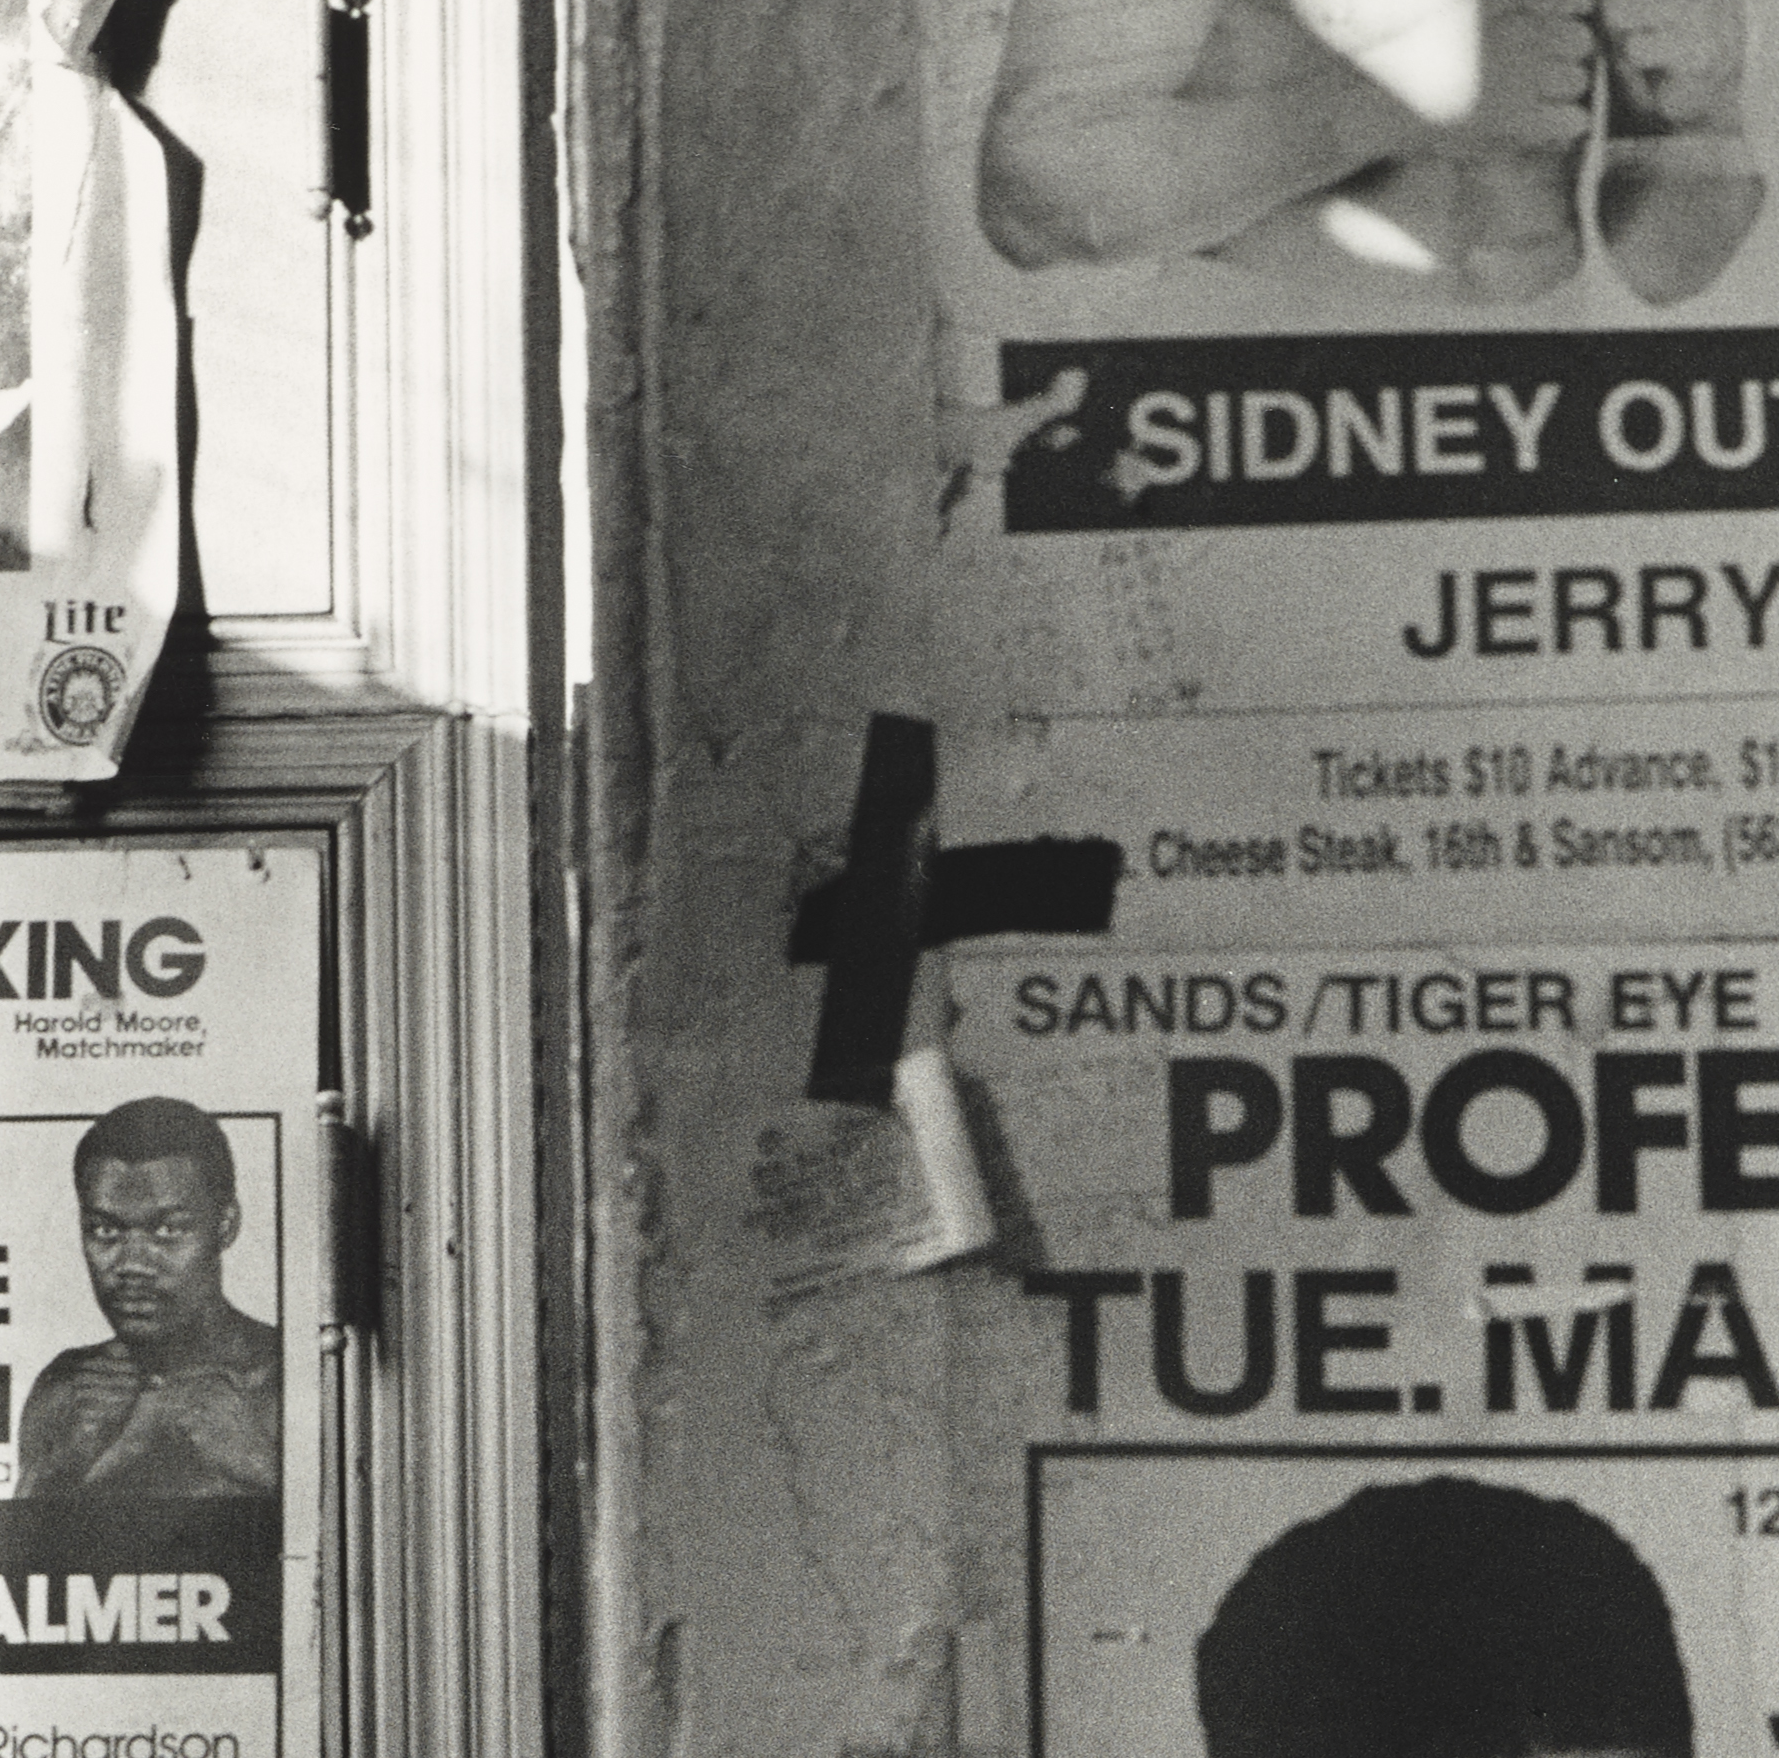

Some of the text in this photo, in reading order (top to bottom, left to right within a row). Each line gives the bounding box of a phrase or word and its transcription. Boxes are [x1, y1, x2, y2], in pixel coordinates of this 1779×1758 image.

[1127, 381, 1562, 487] SIDNEY
[41, 599, 128, 646] Lite
[1312, 743, 1452, 803] Tickets
[1543, 739, 1720, 795] Advance,
[1515, 820, 1541, 871] &
[13, 1008, 209, 1035] Harold Moore,
[1609, 971, 1758, 1031] EYE
[35, 1037, 205, 1060] Matchmaker
[1022, 1265, 1444, 1419] TUE.
